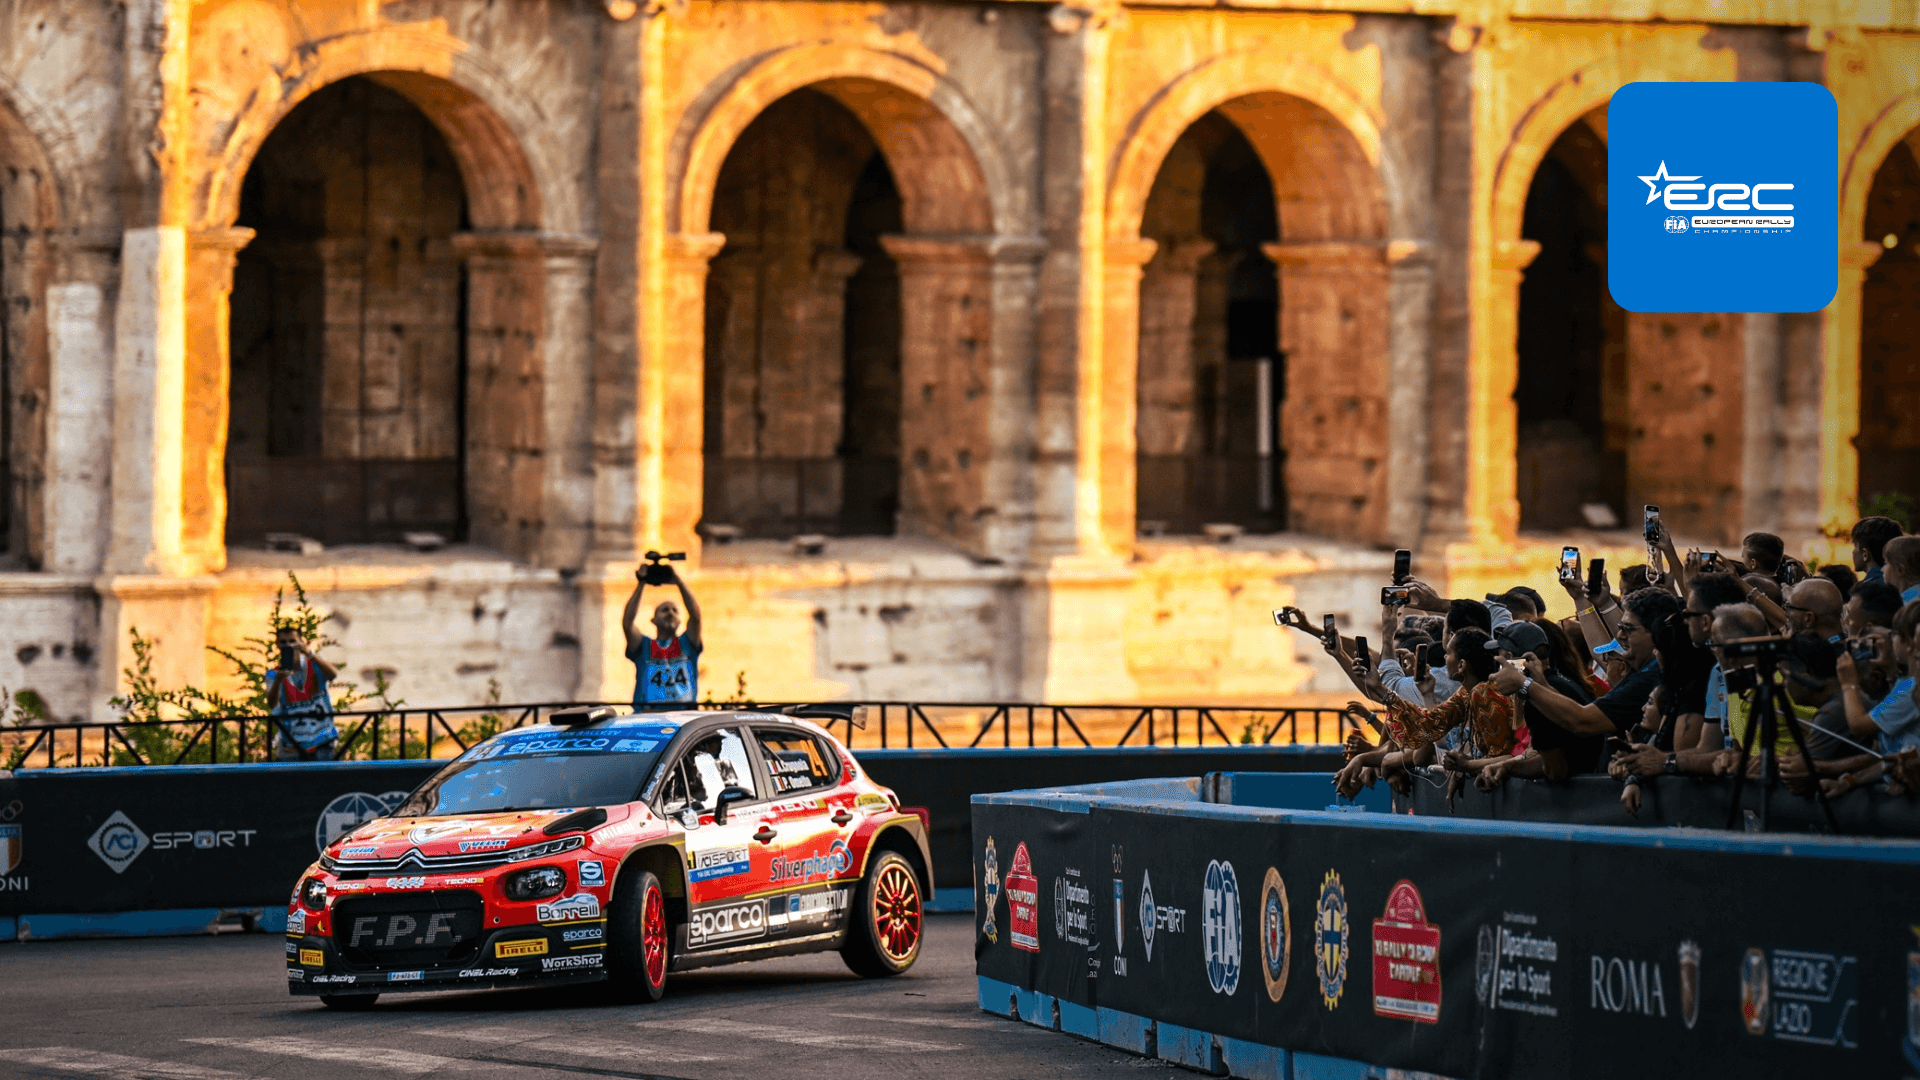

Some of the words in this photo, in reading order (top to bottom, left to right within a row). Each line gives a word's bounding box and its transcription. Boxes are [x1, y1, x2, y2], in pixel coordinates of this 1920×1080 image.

[650, 668, 687, 688] 424
[508, 737, 611, 755] sparco
[152, 830, 257, 850] SPORT
[715, 849, 748, 866] SPORT
[769, 849, 846, 884] Silverphage
[690, 904, 763, 943] sparco
[1156, 905, 1186, 933] SPORT
[563, 928, 603, 941] sparco
[500, 940, 544, 955] PIRELLI
[458, 968, 485, 978] CINEL
[485, 966, 519, 977] Racing
[1591, 954, 1668, 1018] ROMA
